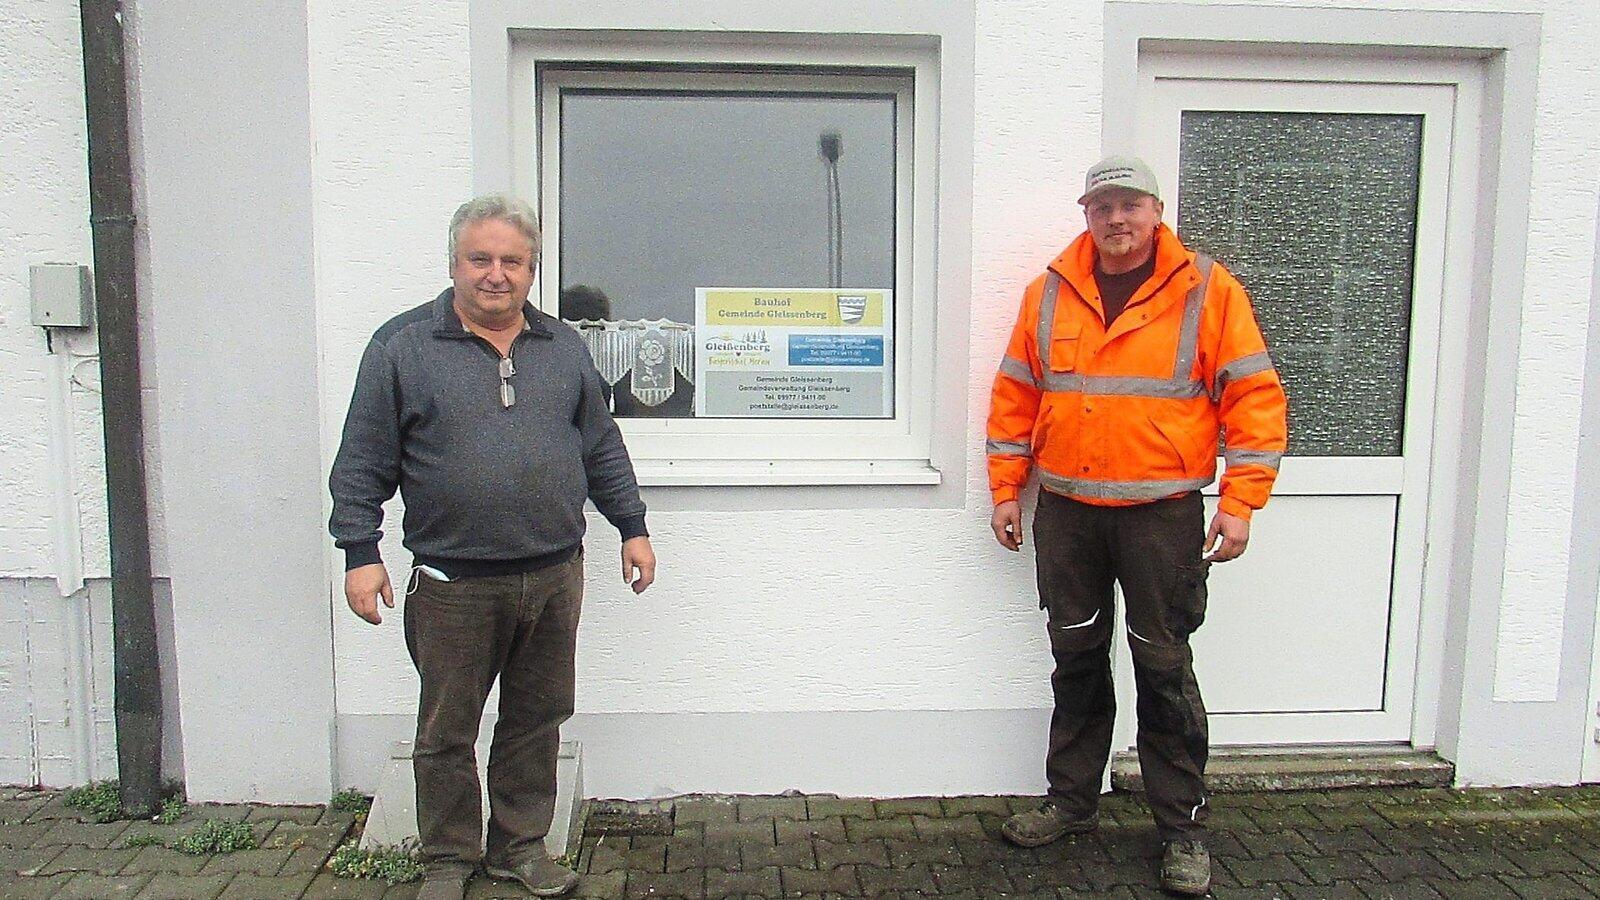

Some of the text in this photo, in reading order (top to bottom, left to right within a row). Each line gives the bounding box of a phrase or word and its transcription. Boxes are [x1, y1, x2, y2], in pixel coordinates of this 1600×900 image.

[754, 298, 791, 306] Bauhof
[718, 310, 827, 319] Gemeinde Gleissenberg
[705, 342, 771, 352] Gleißenberg
